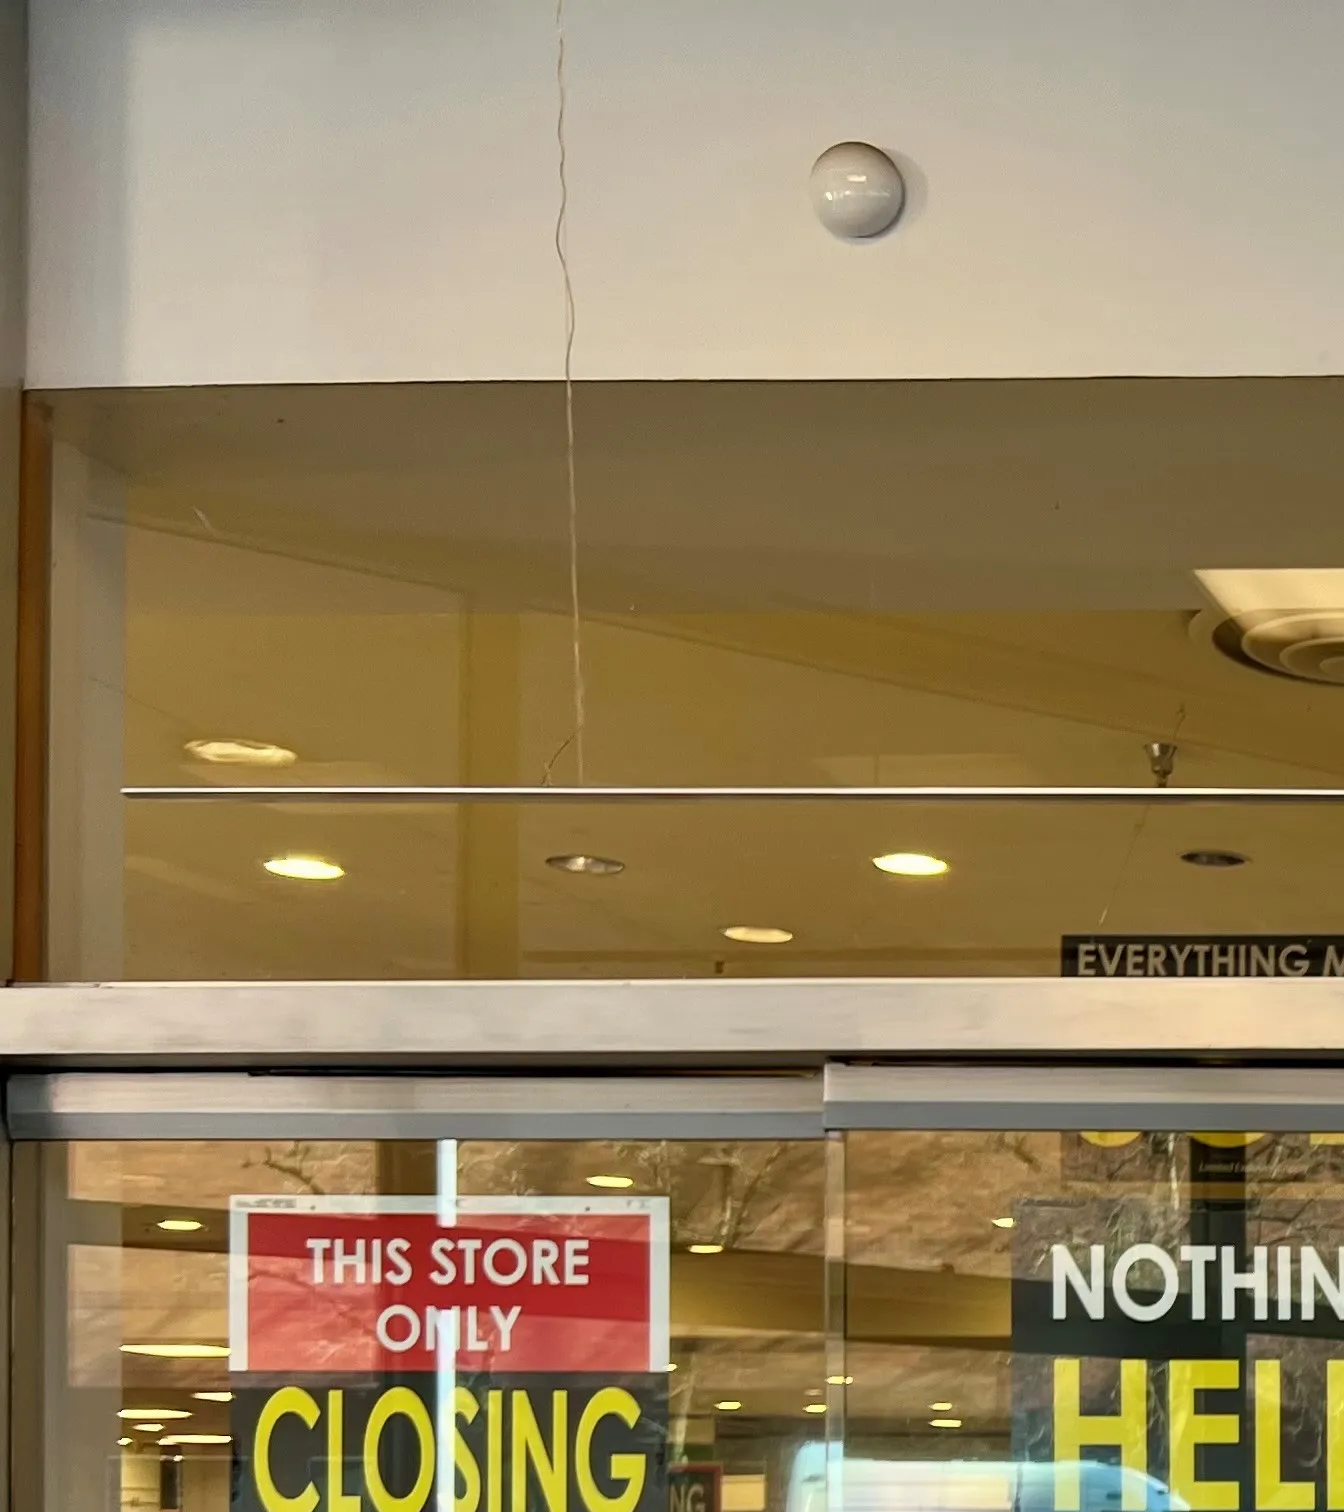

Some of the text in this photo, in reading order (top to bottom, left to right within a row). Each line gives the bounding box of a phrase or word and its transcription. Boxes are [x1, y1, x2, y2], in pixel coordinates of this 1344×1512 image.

[1078, 943, 1308, 977] EVERYTHING
[306, 1237, 591, 1287] THIS STORE
[376, 1304, 522, 1353] ONLY
